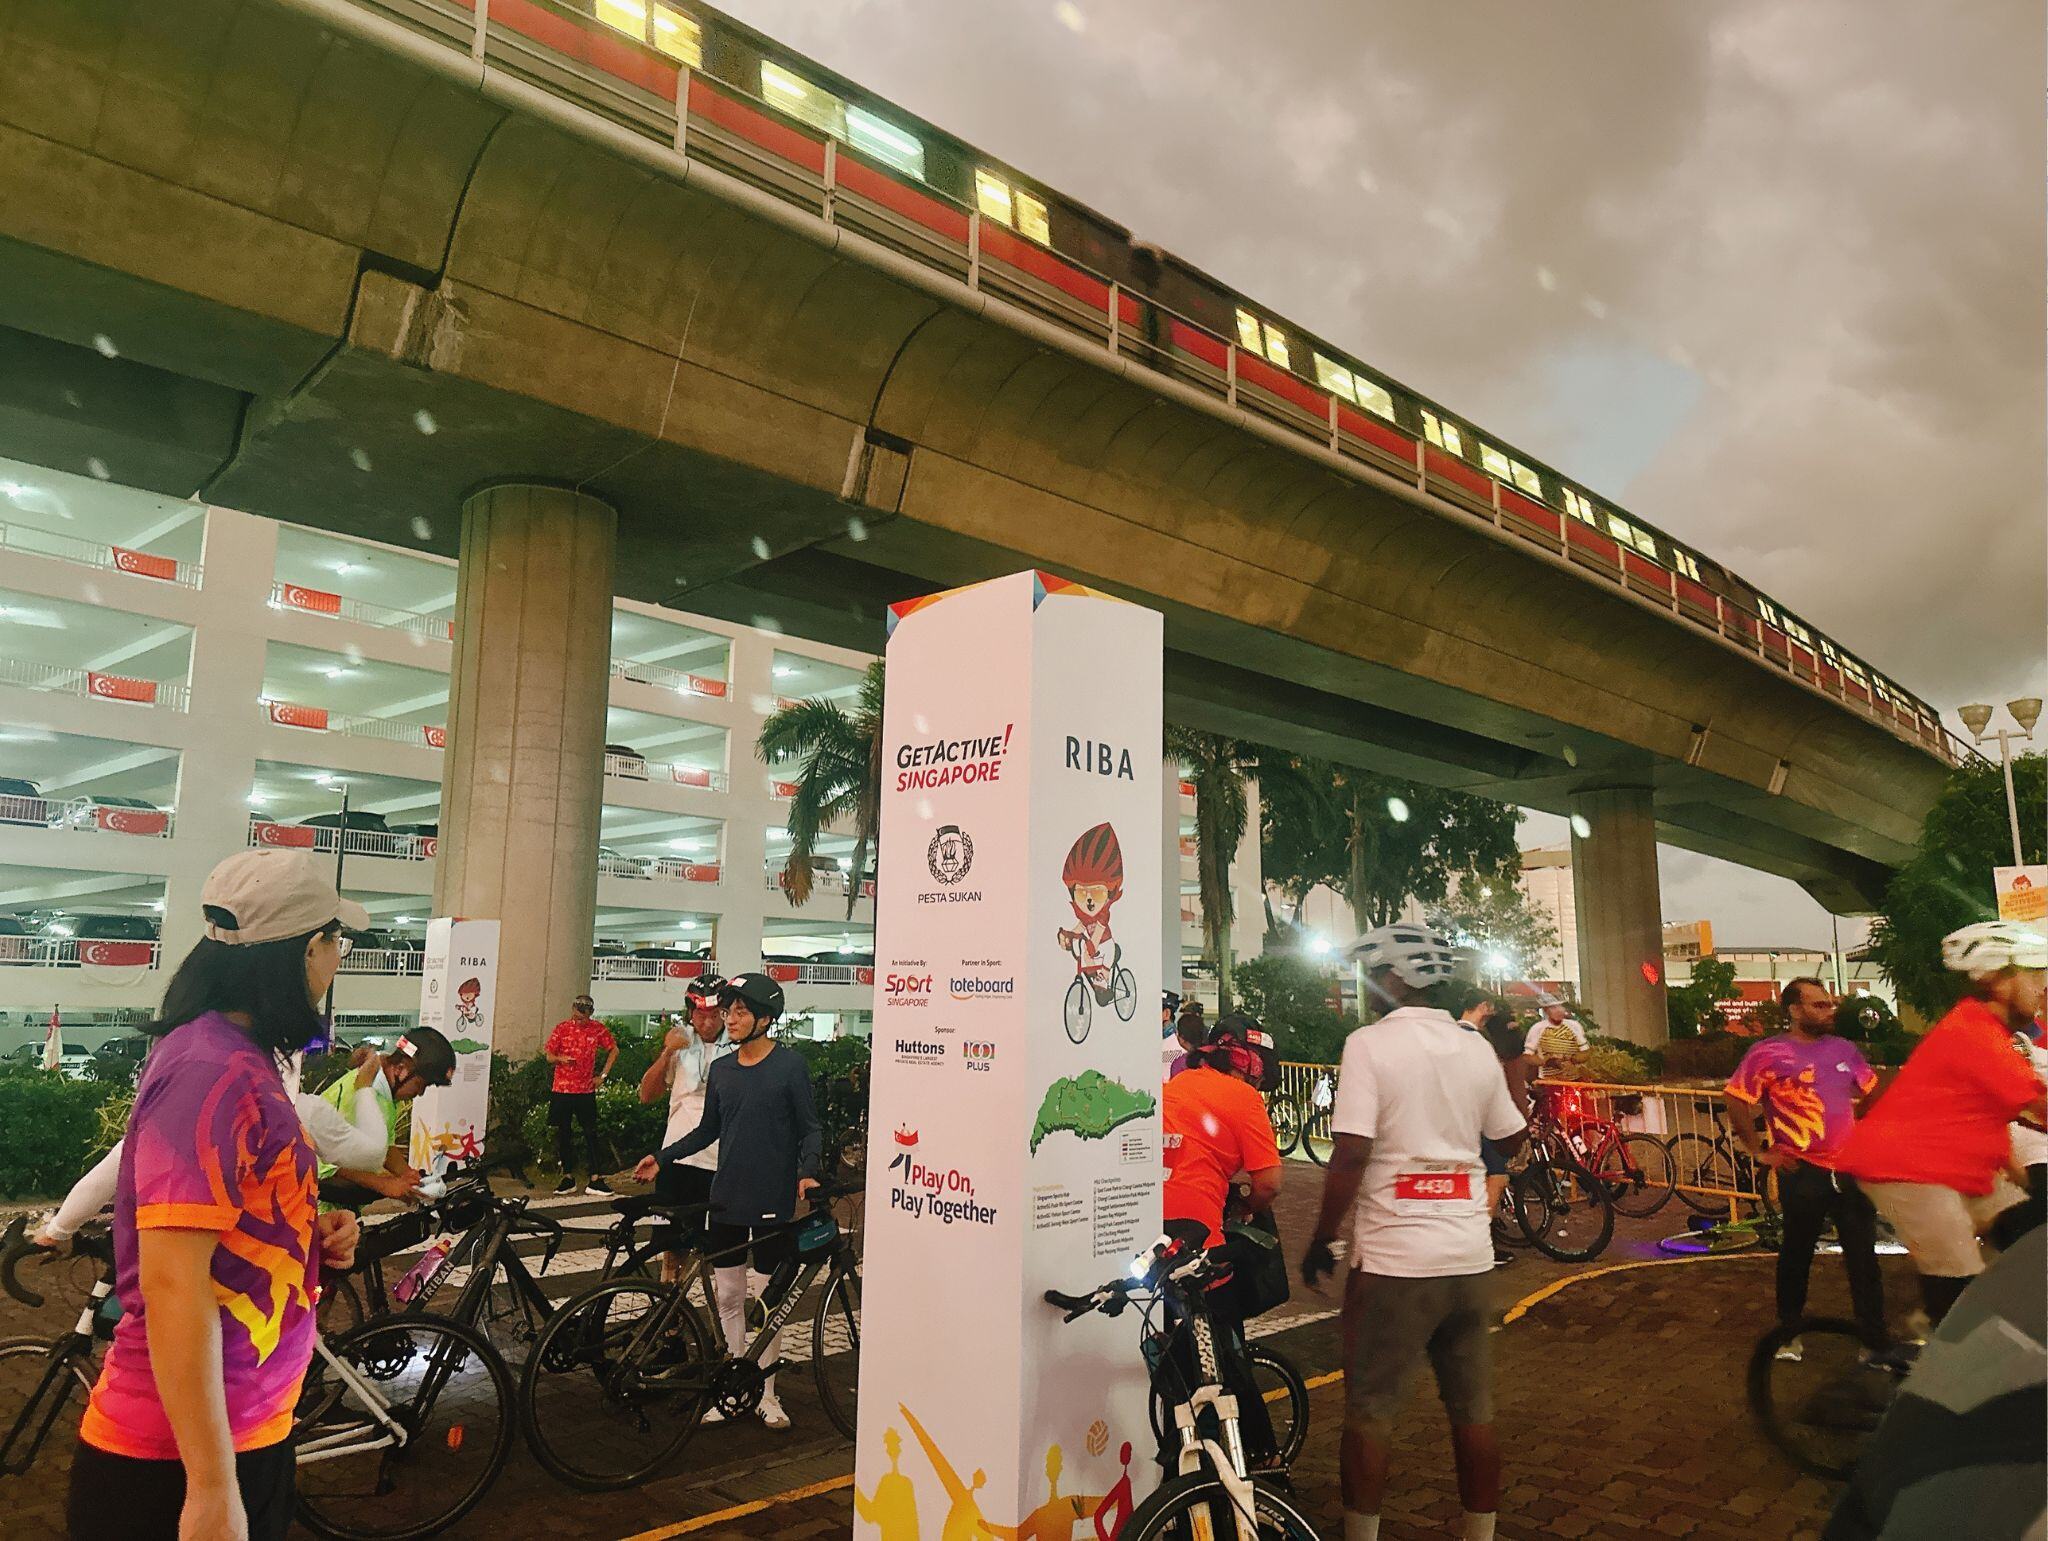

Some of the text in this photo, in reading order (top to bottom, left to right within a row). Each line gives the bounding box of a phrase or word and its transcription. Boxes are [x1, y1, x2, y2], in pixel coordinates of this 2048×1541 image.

[1065, 735, 1134, 781] RIBA
[896, 760, 1001, 792] SINGAPORE
[918, 891, 982, 904] PESTA SUKAN
[460, 957, 487, 967] RIBA
[885, 974, 933, 995] Sport
[950, 977, 1013, 993] toteboard
[888, 998, 928, 1007] SINGAPORE
[895, 1040, 945, 1054] Huttons
[967, 1061, 990, 1071] PLUS
[912, 1165, 975, 1196] Play On,
[891, 1188, 997, 1225] Play Together
[419, 1261, 454, 1301] TRIBAN
[768, 1286, 803, 1331] TRIBAN
